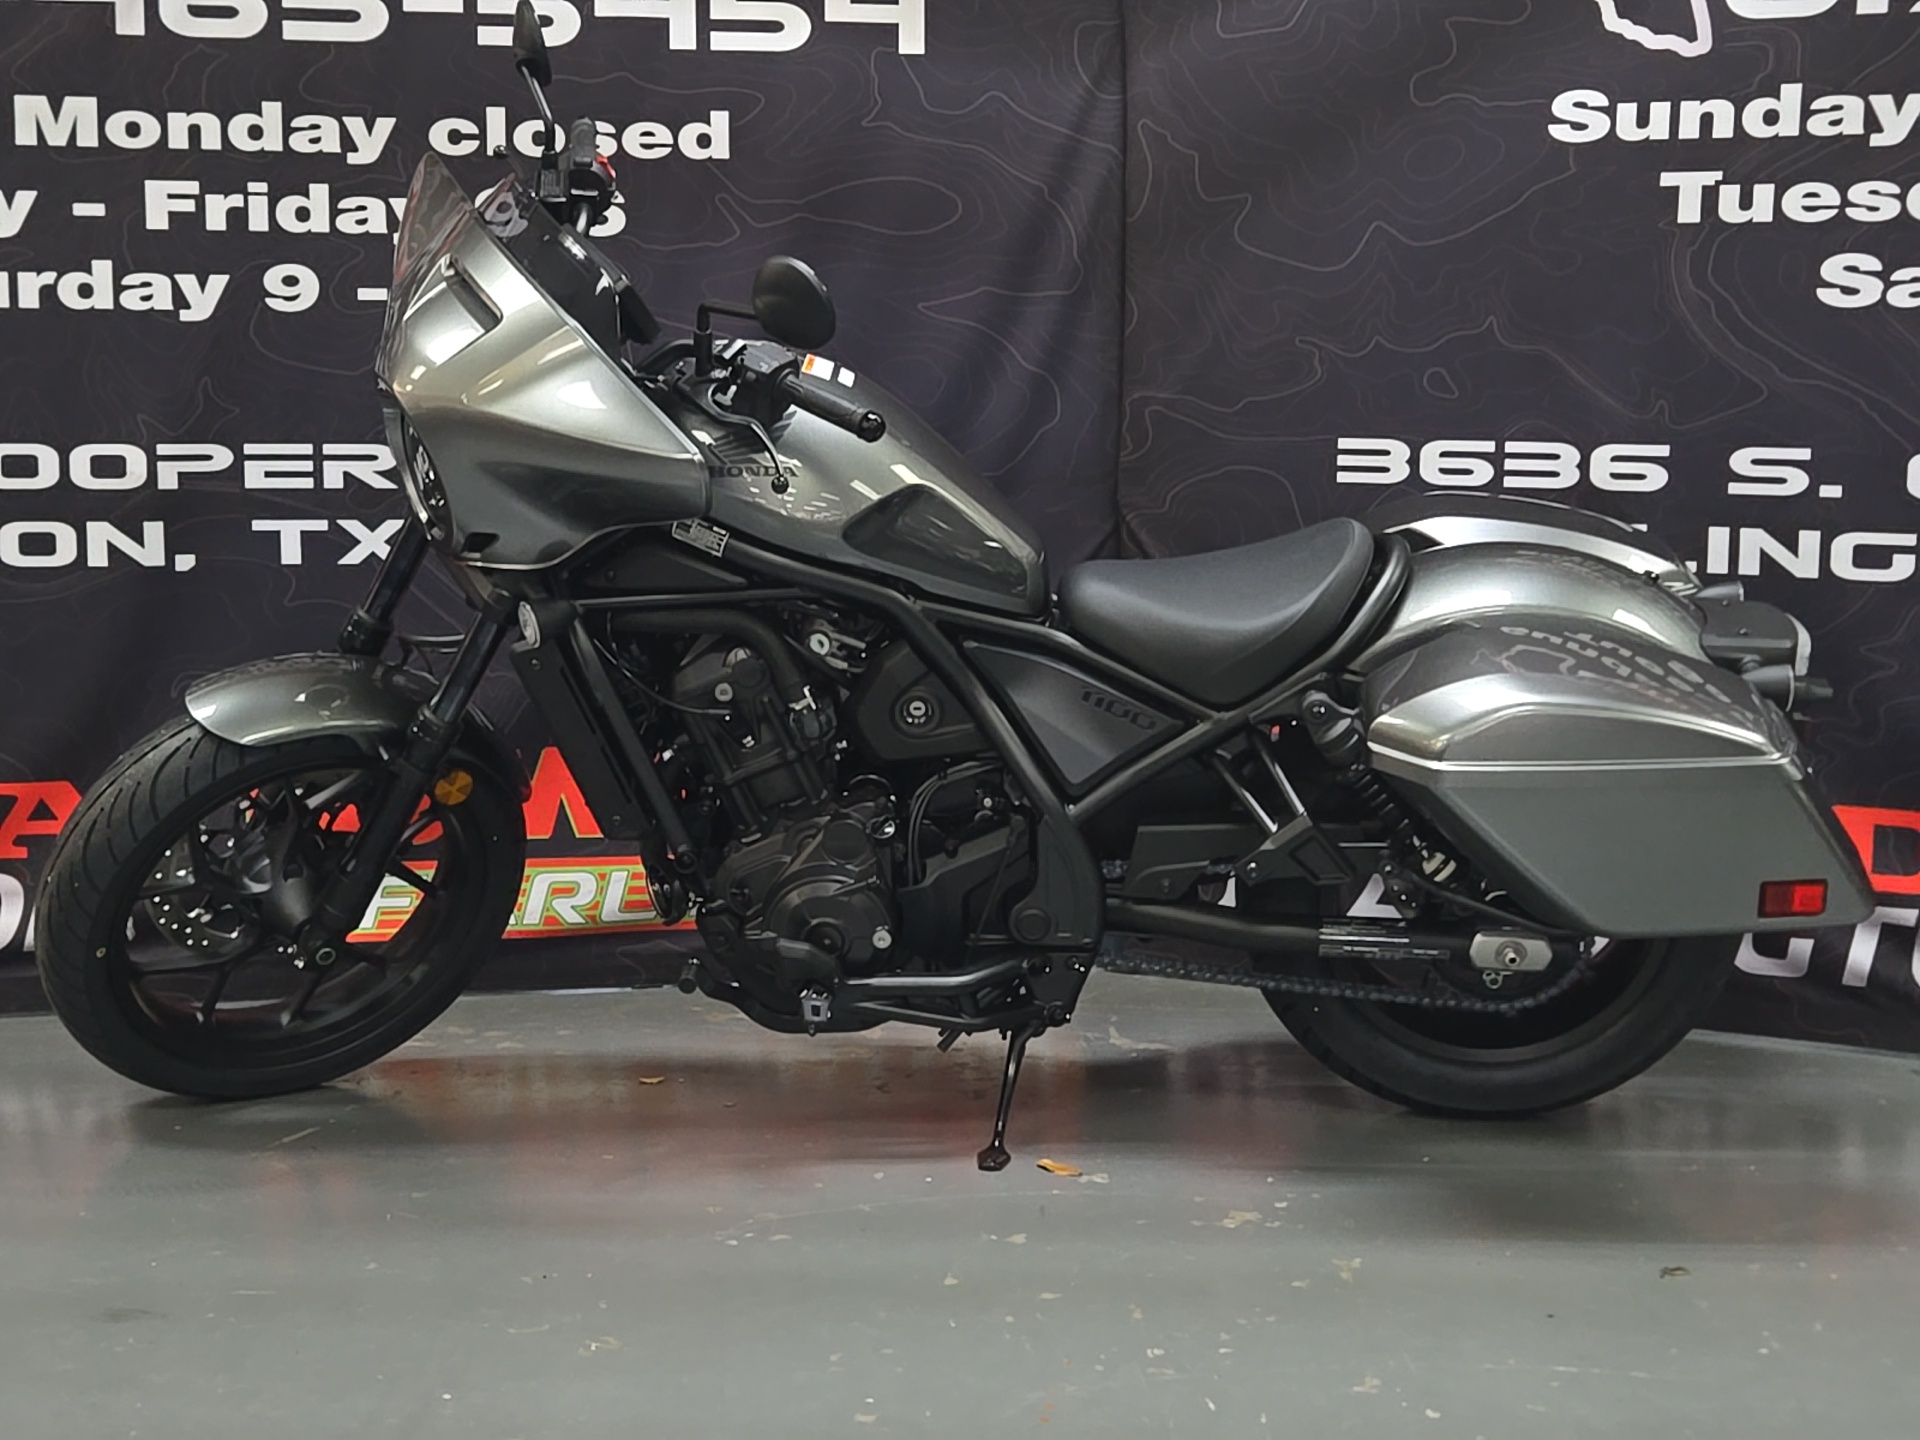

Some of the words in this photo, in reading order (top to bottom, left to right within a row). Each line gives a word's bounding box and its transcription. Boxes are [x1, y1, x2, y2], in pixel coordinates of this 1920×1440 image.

[13, 94, 397, 165] Monday
[427, 106, 731, 160] closed
[1547, 82, 1920, 147] Sunday
[1659, 170, 1920, 224] Tues
[0, 259, 230, 322] rday
[262, 263, 320, 312] 9
[708, 465, 800, 478] HONDA
[1336, 437, 1671, 492] 3636
[1727, 447, 1843, 498] S.
[251, 519, 405, 565] TX
[1630, 523, 1918, 582] ING
